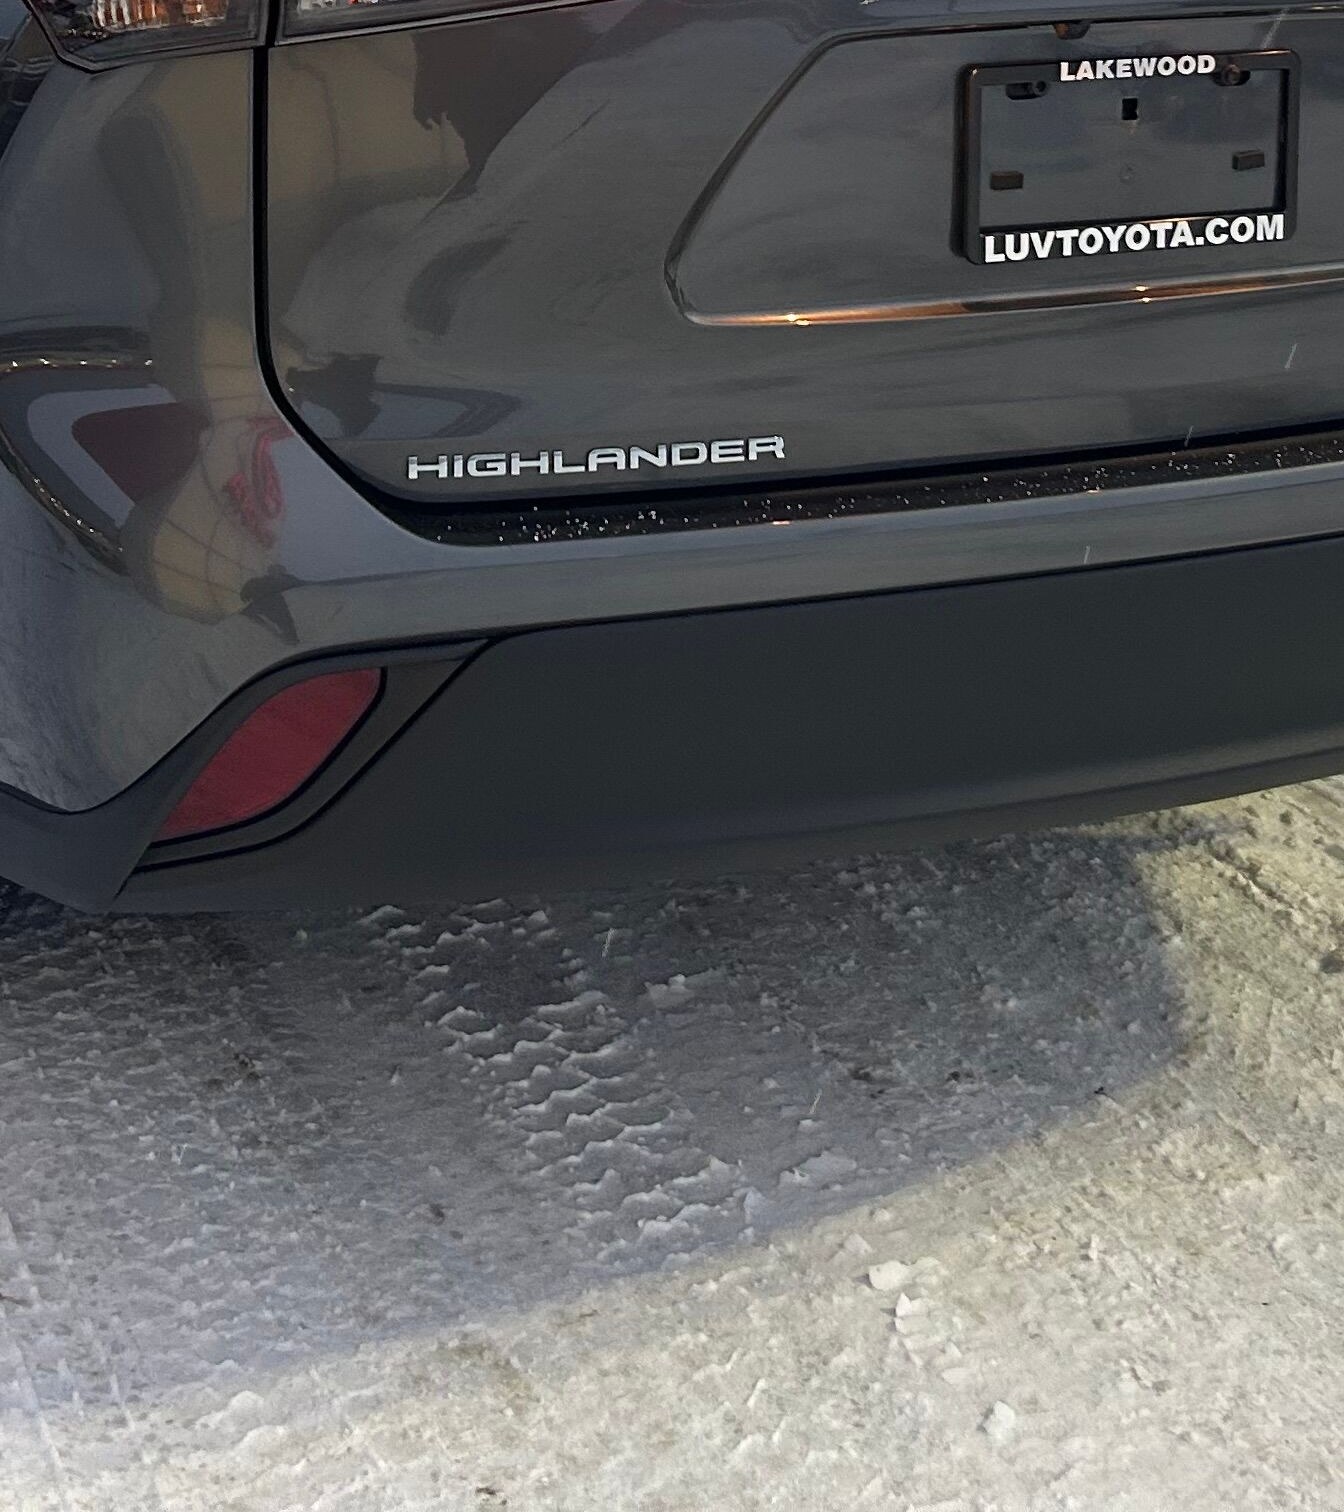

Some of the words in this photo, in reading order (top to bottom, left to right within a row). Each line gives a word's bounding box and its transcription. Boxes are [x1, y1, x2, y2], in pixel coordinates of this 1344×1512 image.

[1059, 53, 1217, 82] LAKEWOOD
[983, 213, 1286, 264] LUVTOYOTA.COM
[407, 435, 786, 480] HIGHLANDER
